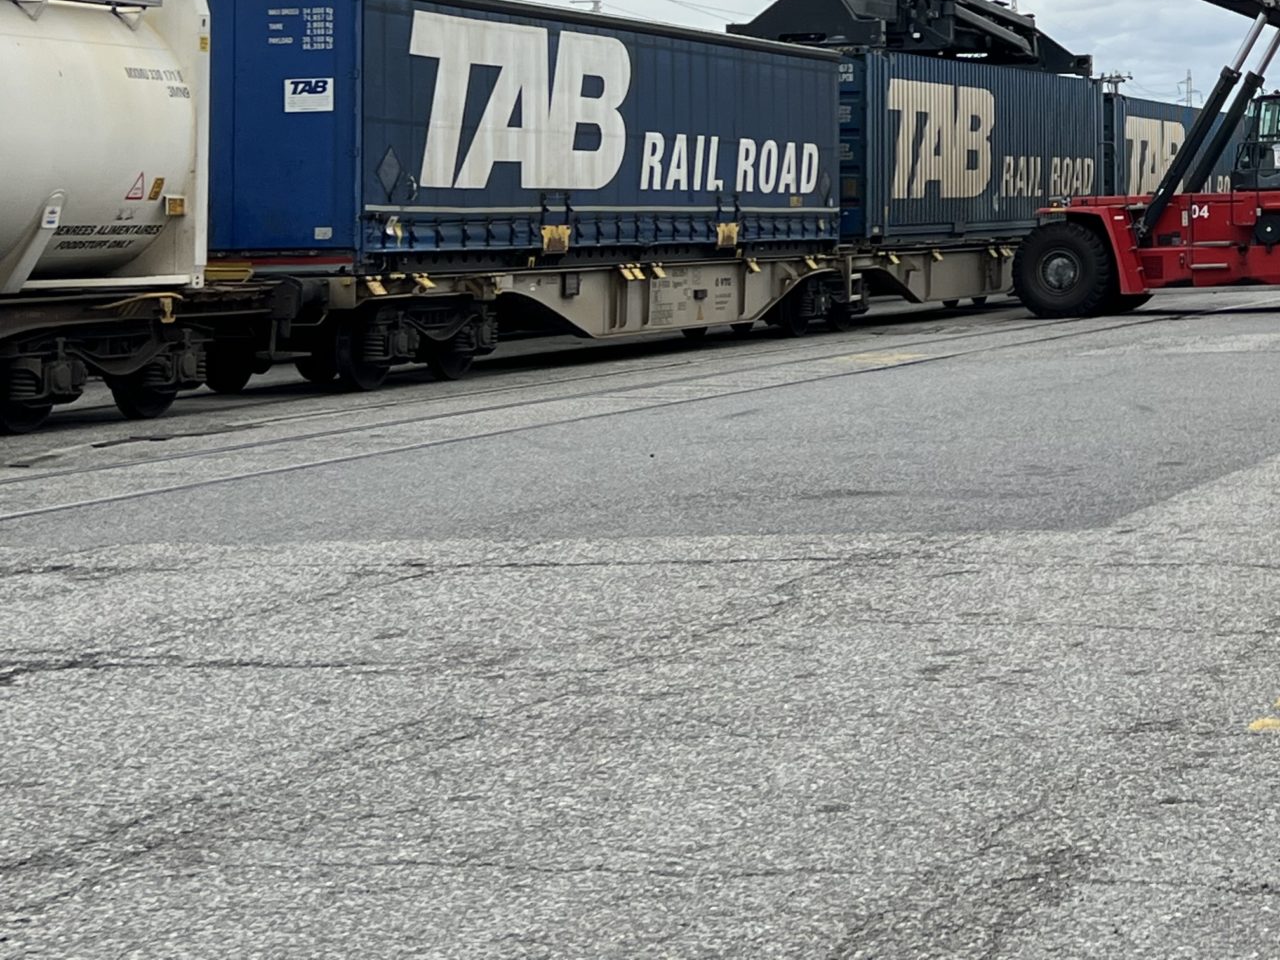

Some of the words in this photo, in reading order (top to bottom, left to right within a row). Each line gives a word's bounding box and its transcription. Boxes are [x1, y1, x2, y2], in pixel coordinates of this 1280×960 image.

[290, 80, 328, 95] TAB
[409, 10, 632, 190] TAB
[640, 132, 722, 192] RAIL
[736, 138, 819, 194] ROAD
[888, 78, 995, 199] TAB
[1002, 156, 1042, 197] RAIL
[1050, 156, 1094, 196] ROAD
[1191, 203, 1210, 219] 04
[94, 225, 163, 235] ALIMENTAIRES
[54, 240, 110, 250] FOODSTUFF
[107, 239, 136, 249] ONLY
